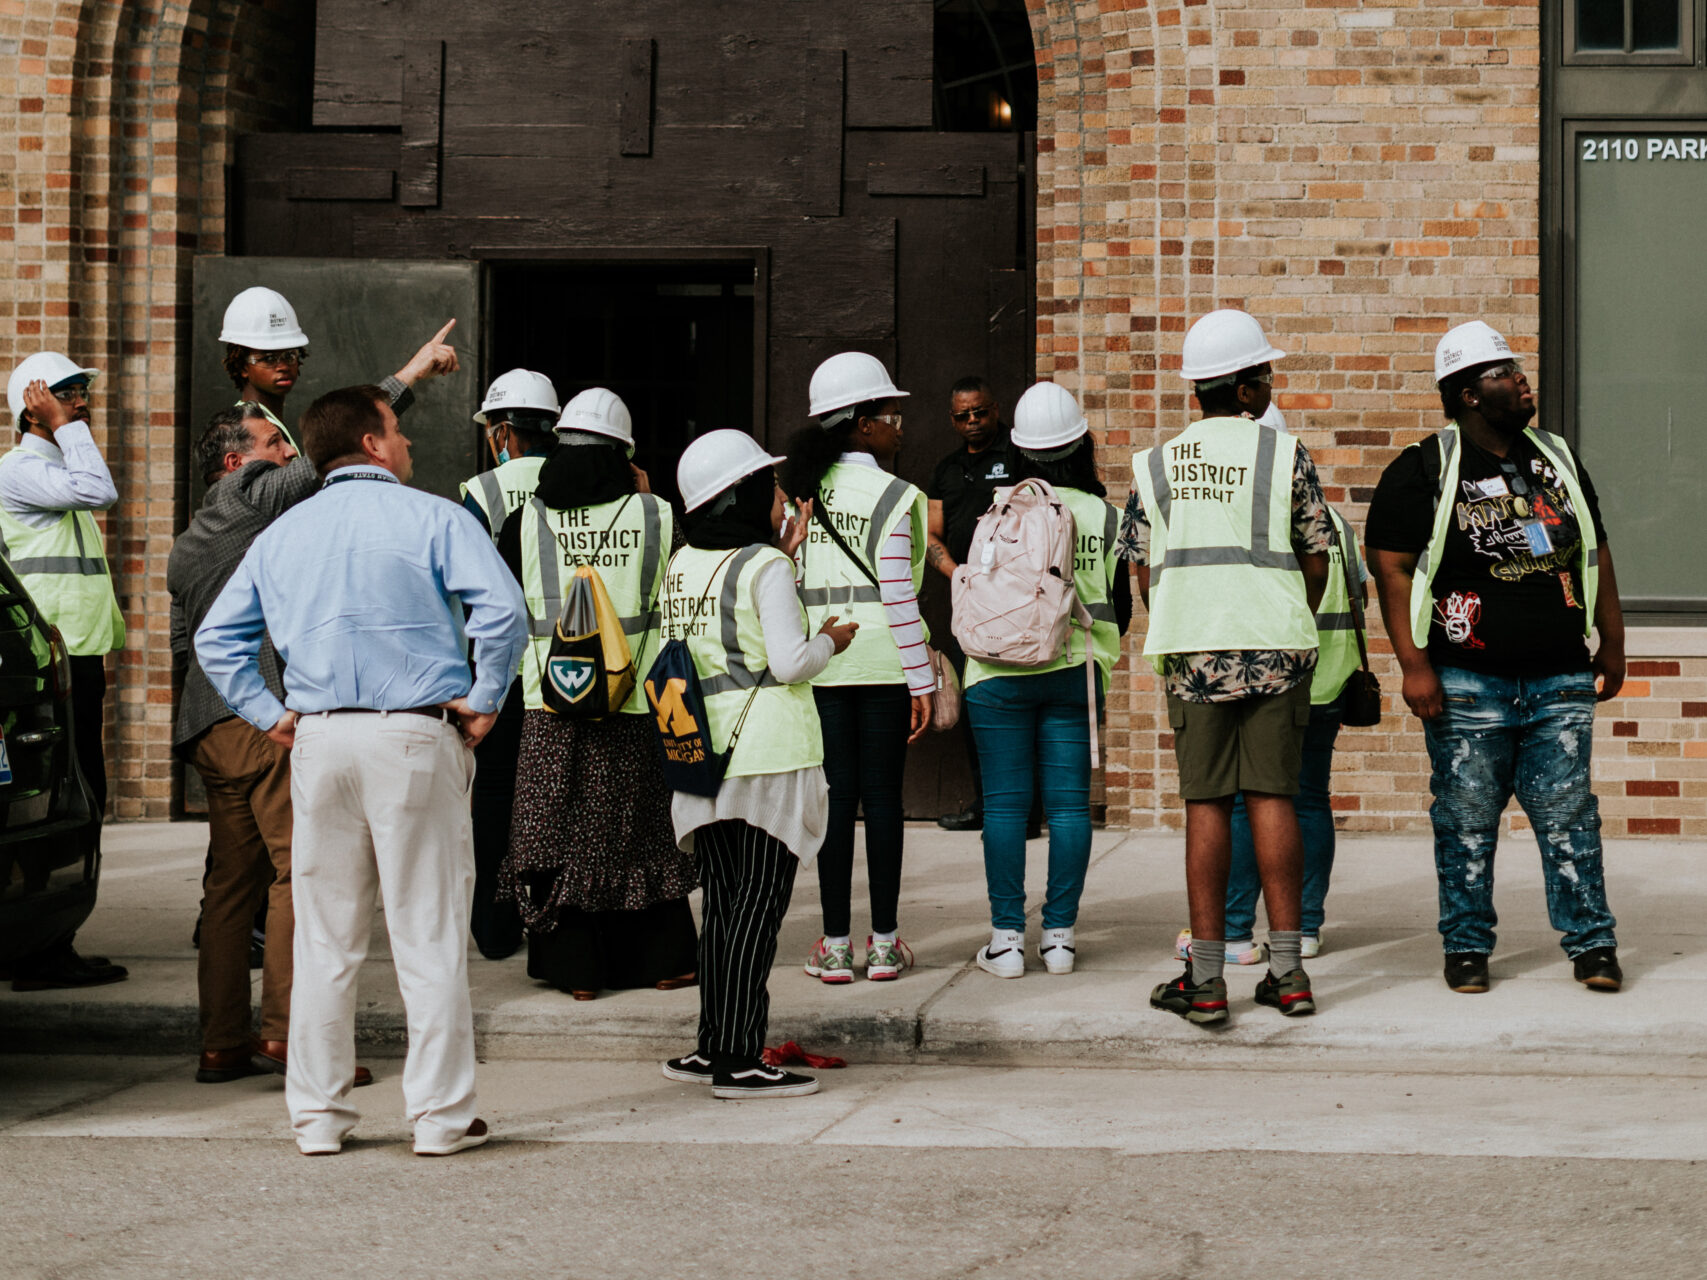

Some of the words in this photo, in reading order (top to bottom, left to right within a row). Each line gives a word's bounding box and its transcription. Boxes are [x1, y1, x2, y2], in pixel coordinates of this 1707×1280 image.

[1583, 139, 1639, 160] 2110
[1171, 441, 1202, 462] THE
[1172, 463, 1248, 487] DISTRICT
[506, 490, 536, 508] TH
[557, 508, 591, 529] THE
[811, 511, 870, 536] DTRICT
[557, 530, 642, 550] DISTRICT
[564, 554, 630, 567] DETROIT
